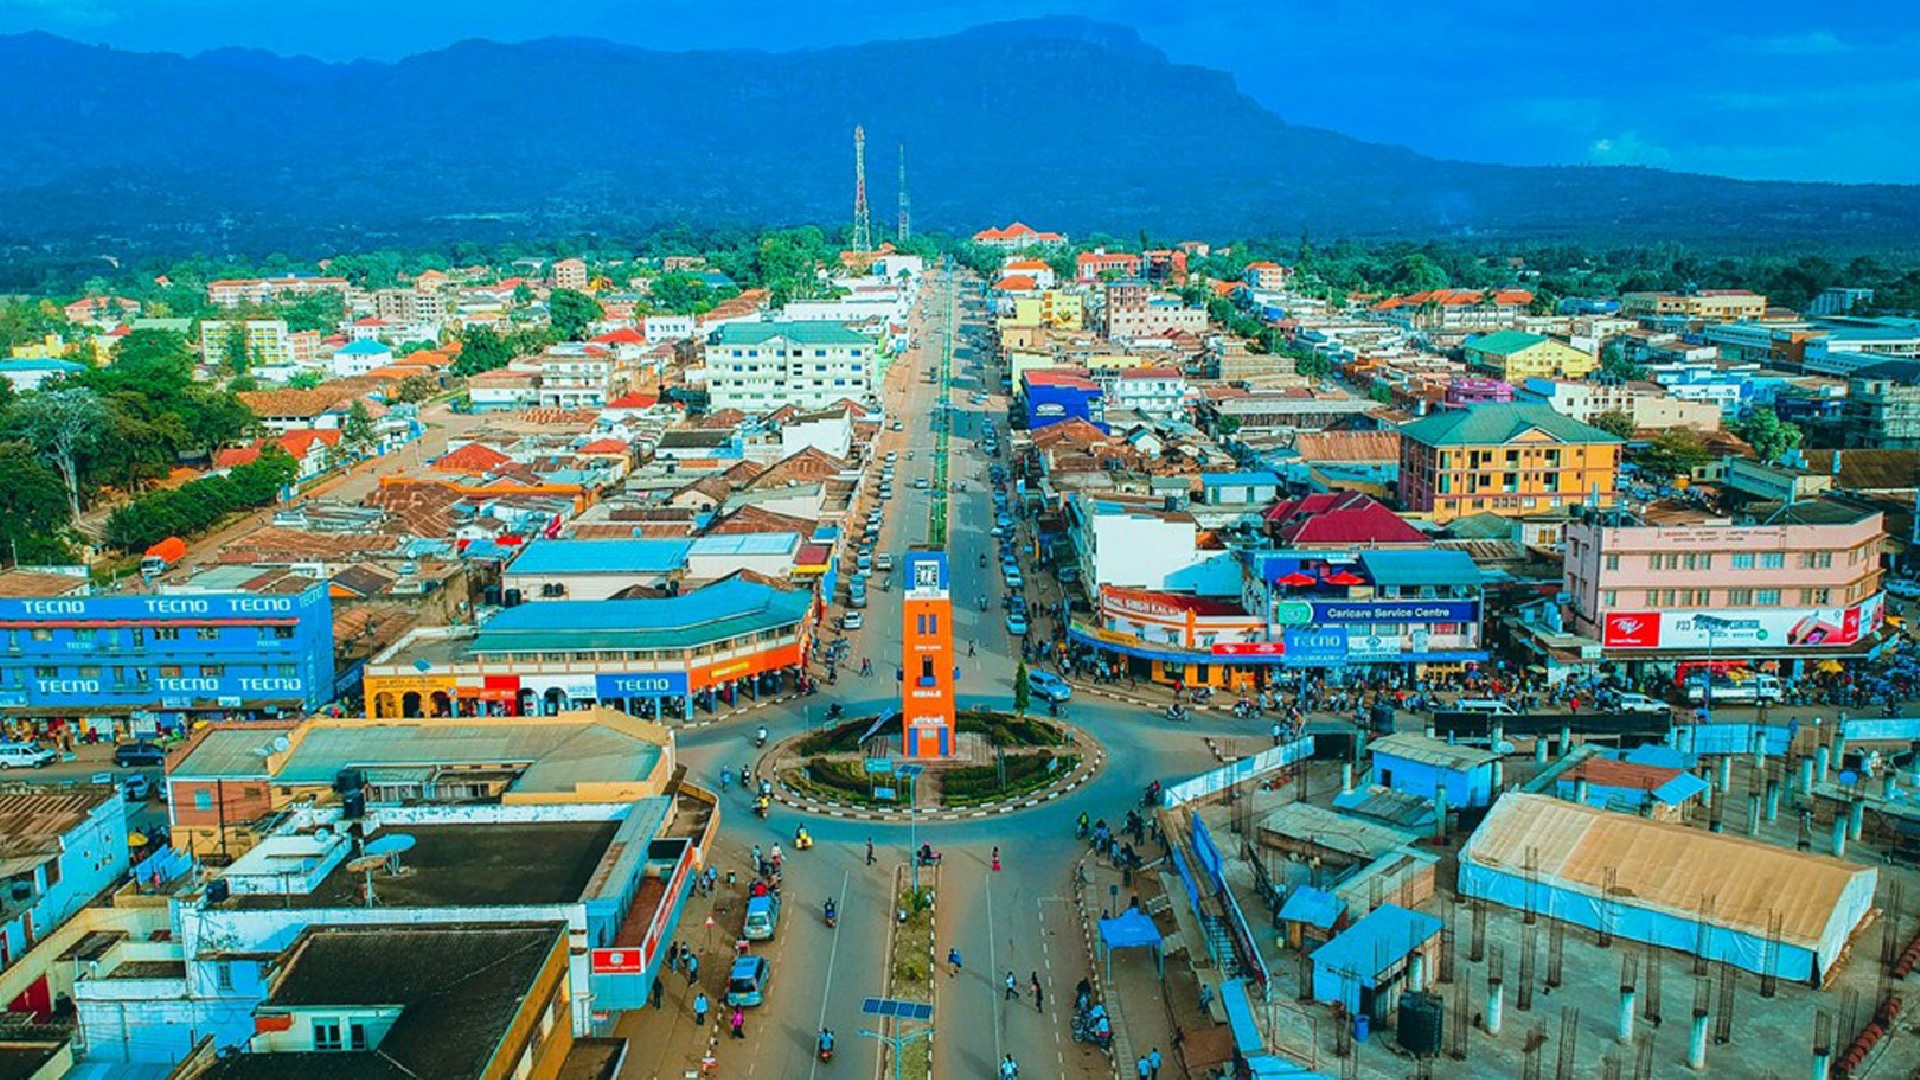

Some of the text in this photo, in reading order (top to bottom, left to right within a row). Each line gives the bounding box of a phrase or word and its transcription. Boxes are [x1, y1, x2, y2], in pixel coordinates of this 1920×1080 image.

[24, 600, 85, 614] TECNO
[148, 600, 208, 613] TECNO
[230, 598, 291, 612] TECNO
[1327, 608, 1450, 618] Caricare Service Centre
[1293, 635, 1341, 647] TECNO
[37, 679, 99, 693] TECNO
[155, 678, 219, 691] TECNO
[238, 678, 301, 691] TECNO
[615, 678, 669, 691] TECNO
